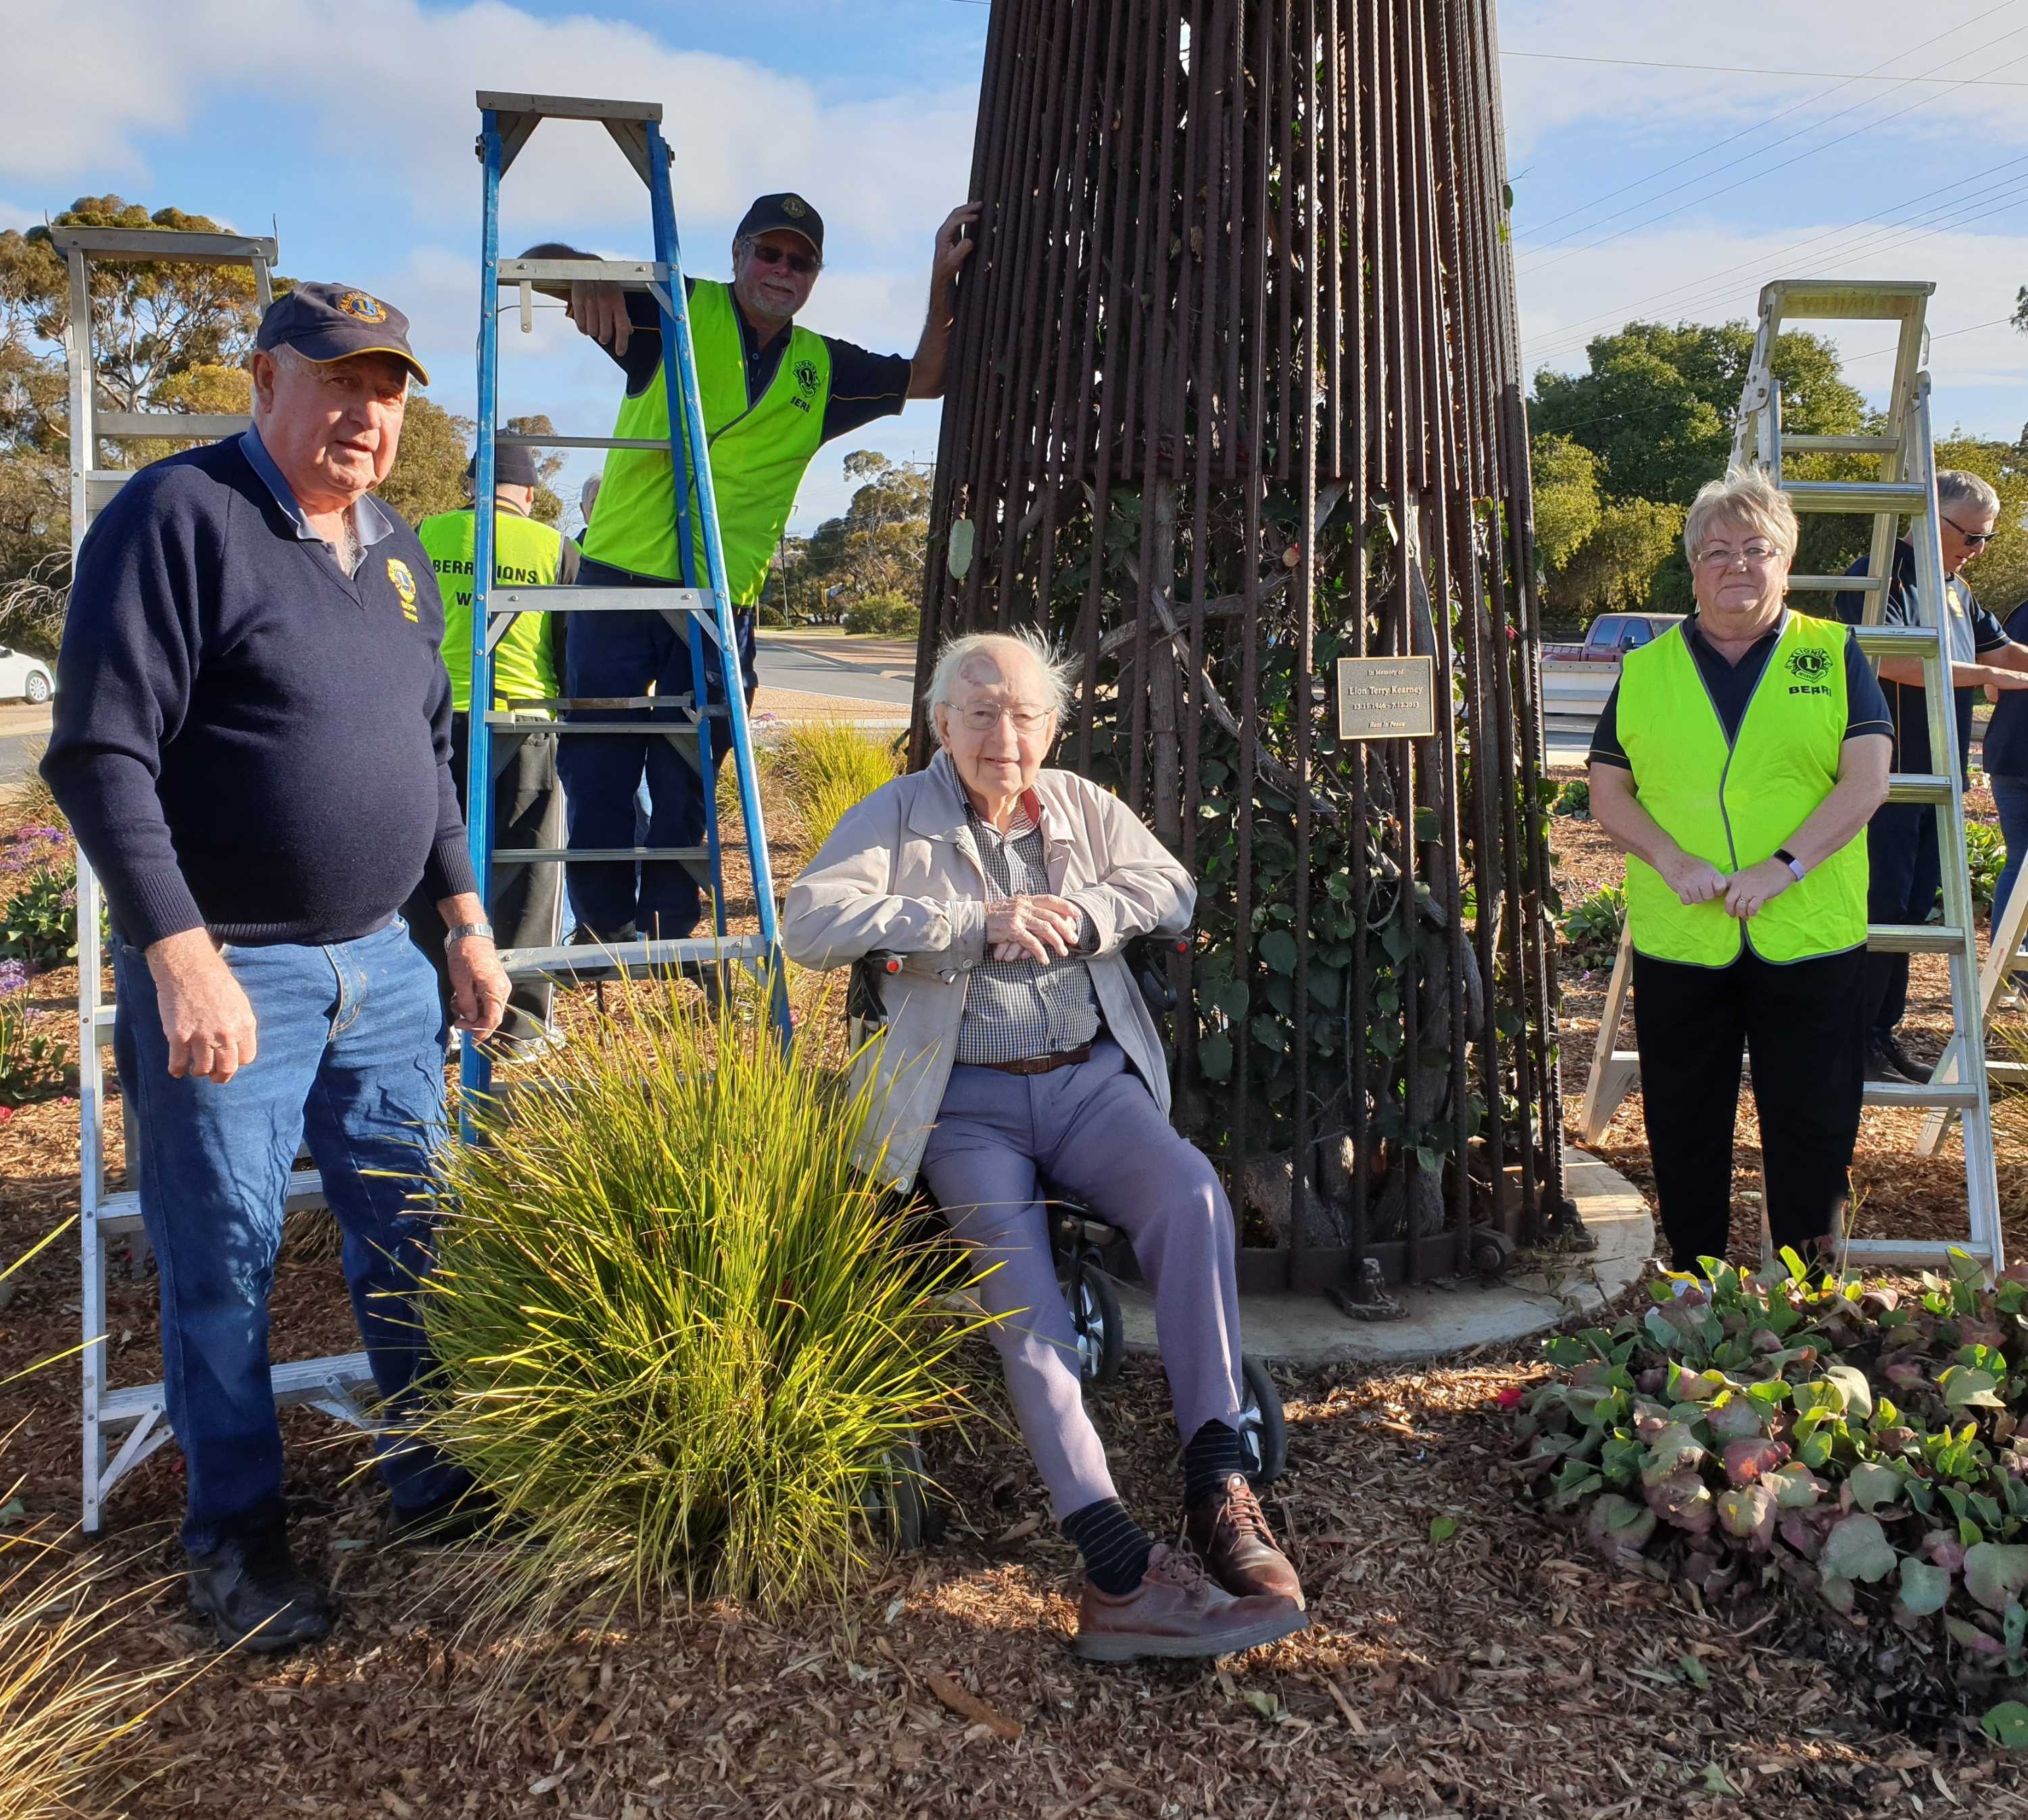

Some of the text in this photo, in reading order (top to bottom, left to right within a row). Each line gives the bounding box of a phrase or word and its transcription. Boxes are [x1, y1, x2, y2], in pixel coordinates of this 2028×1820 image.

[433, 560, 537, 584] BERR IONS
[1349, 685, 1423, 696] Lion Terry Kearney
